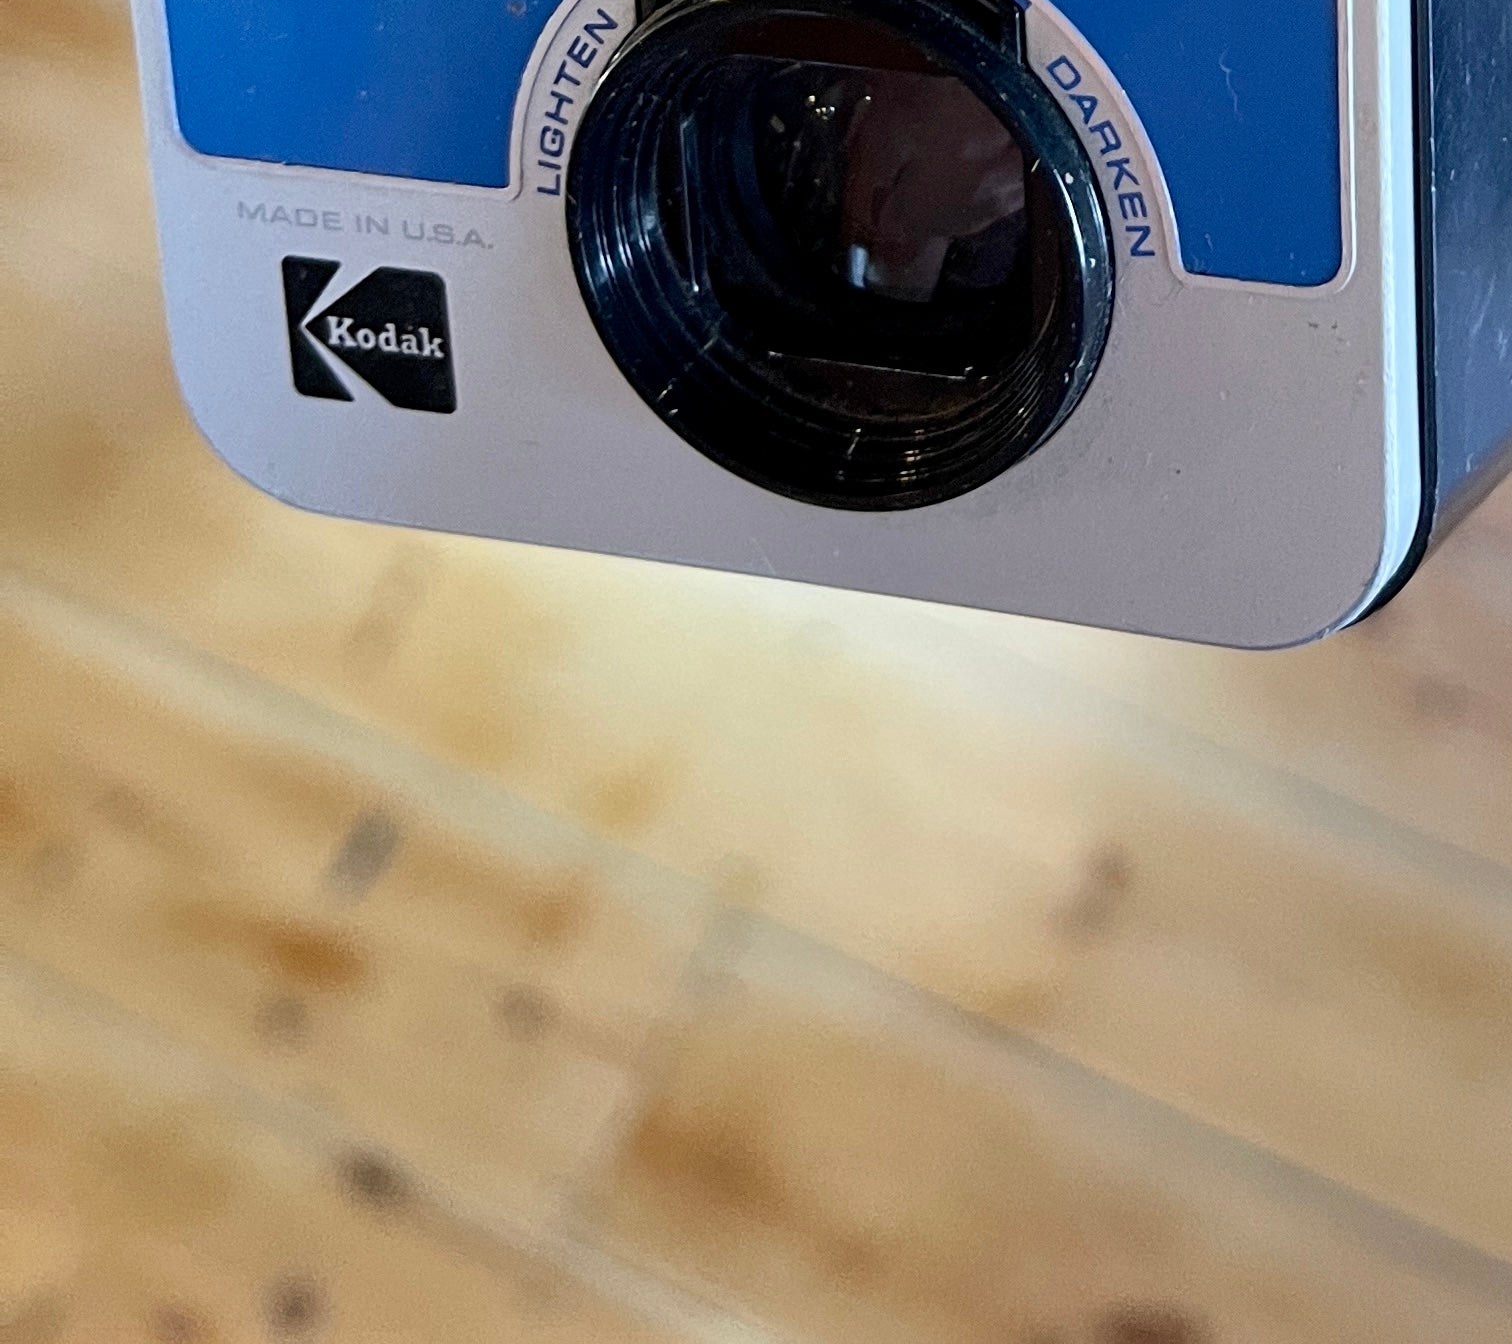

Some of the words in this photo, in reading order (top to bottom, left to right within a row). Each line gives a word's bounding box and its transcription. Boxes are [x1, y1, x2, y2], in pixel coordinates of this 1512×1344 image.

[537, 8, 619, 197] LIGHTEN
[1046, 54, 1156, 259] DARKEN
[236, 201, 344, 231] MADE
[355, 215, 389, 235] IN
[402, 219, 494, 249] U.S.A.
[325, 315, 445, 358] Kodak
